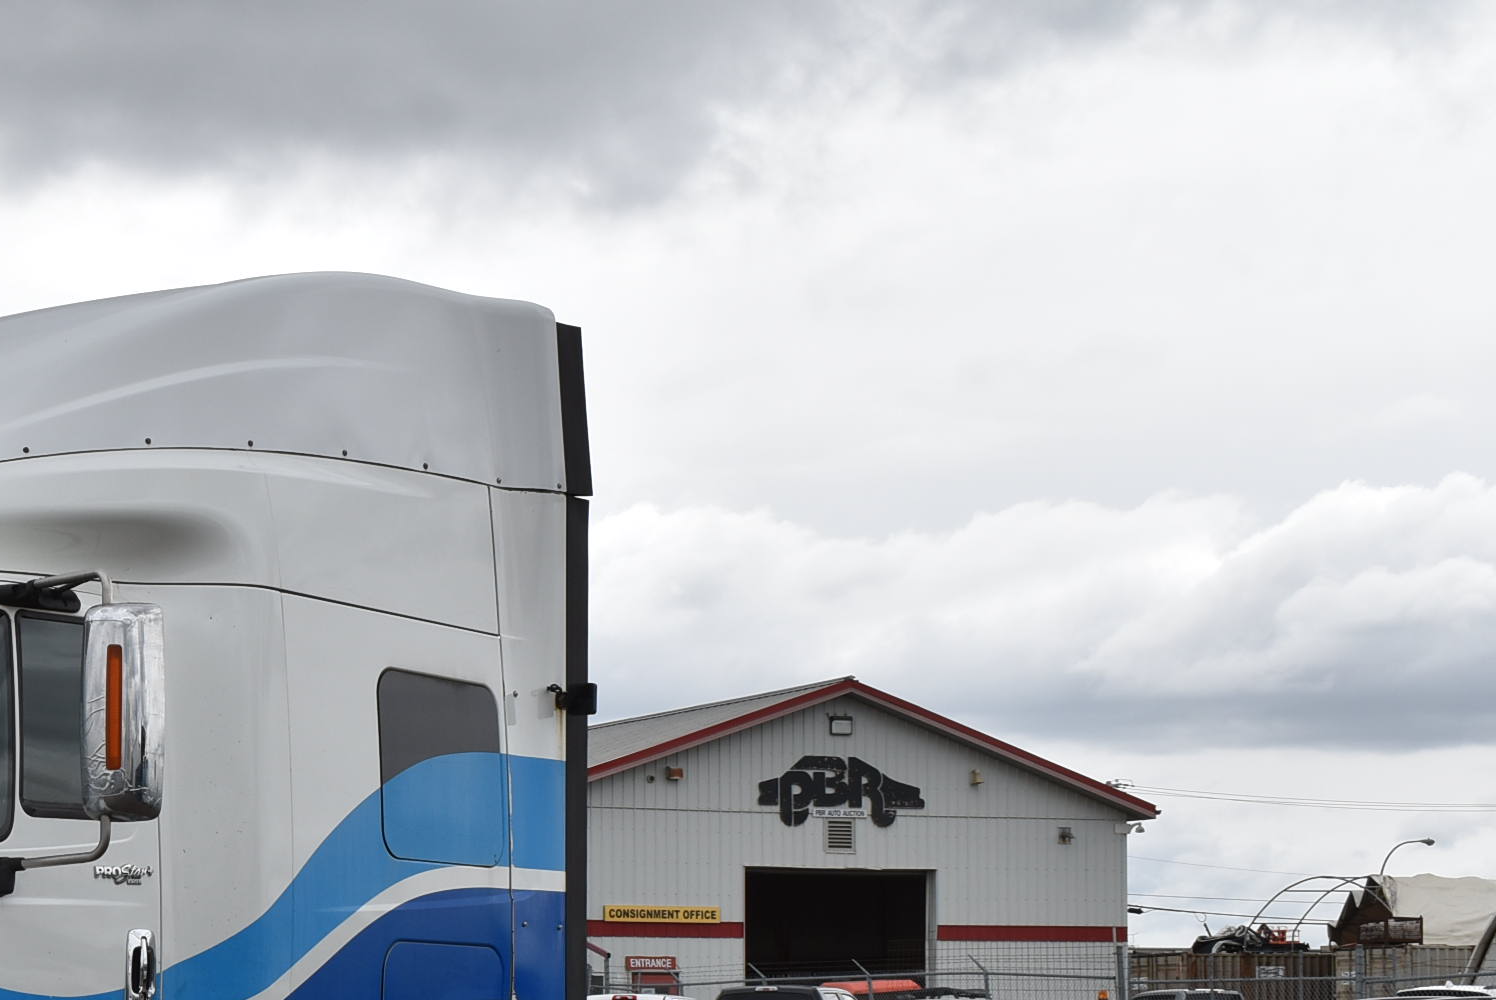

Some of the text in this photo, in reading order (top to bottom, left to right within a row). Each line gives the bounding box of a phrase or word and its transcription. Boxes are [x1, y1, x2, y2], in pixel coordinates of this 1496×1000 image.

[608, 908, 717, 920] CONSIGNMENT OFFICE
[630, 958, 672, 968] ENTRANCE
